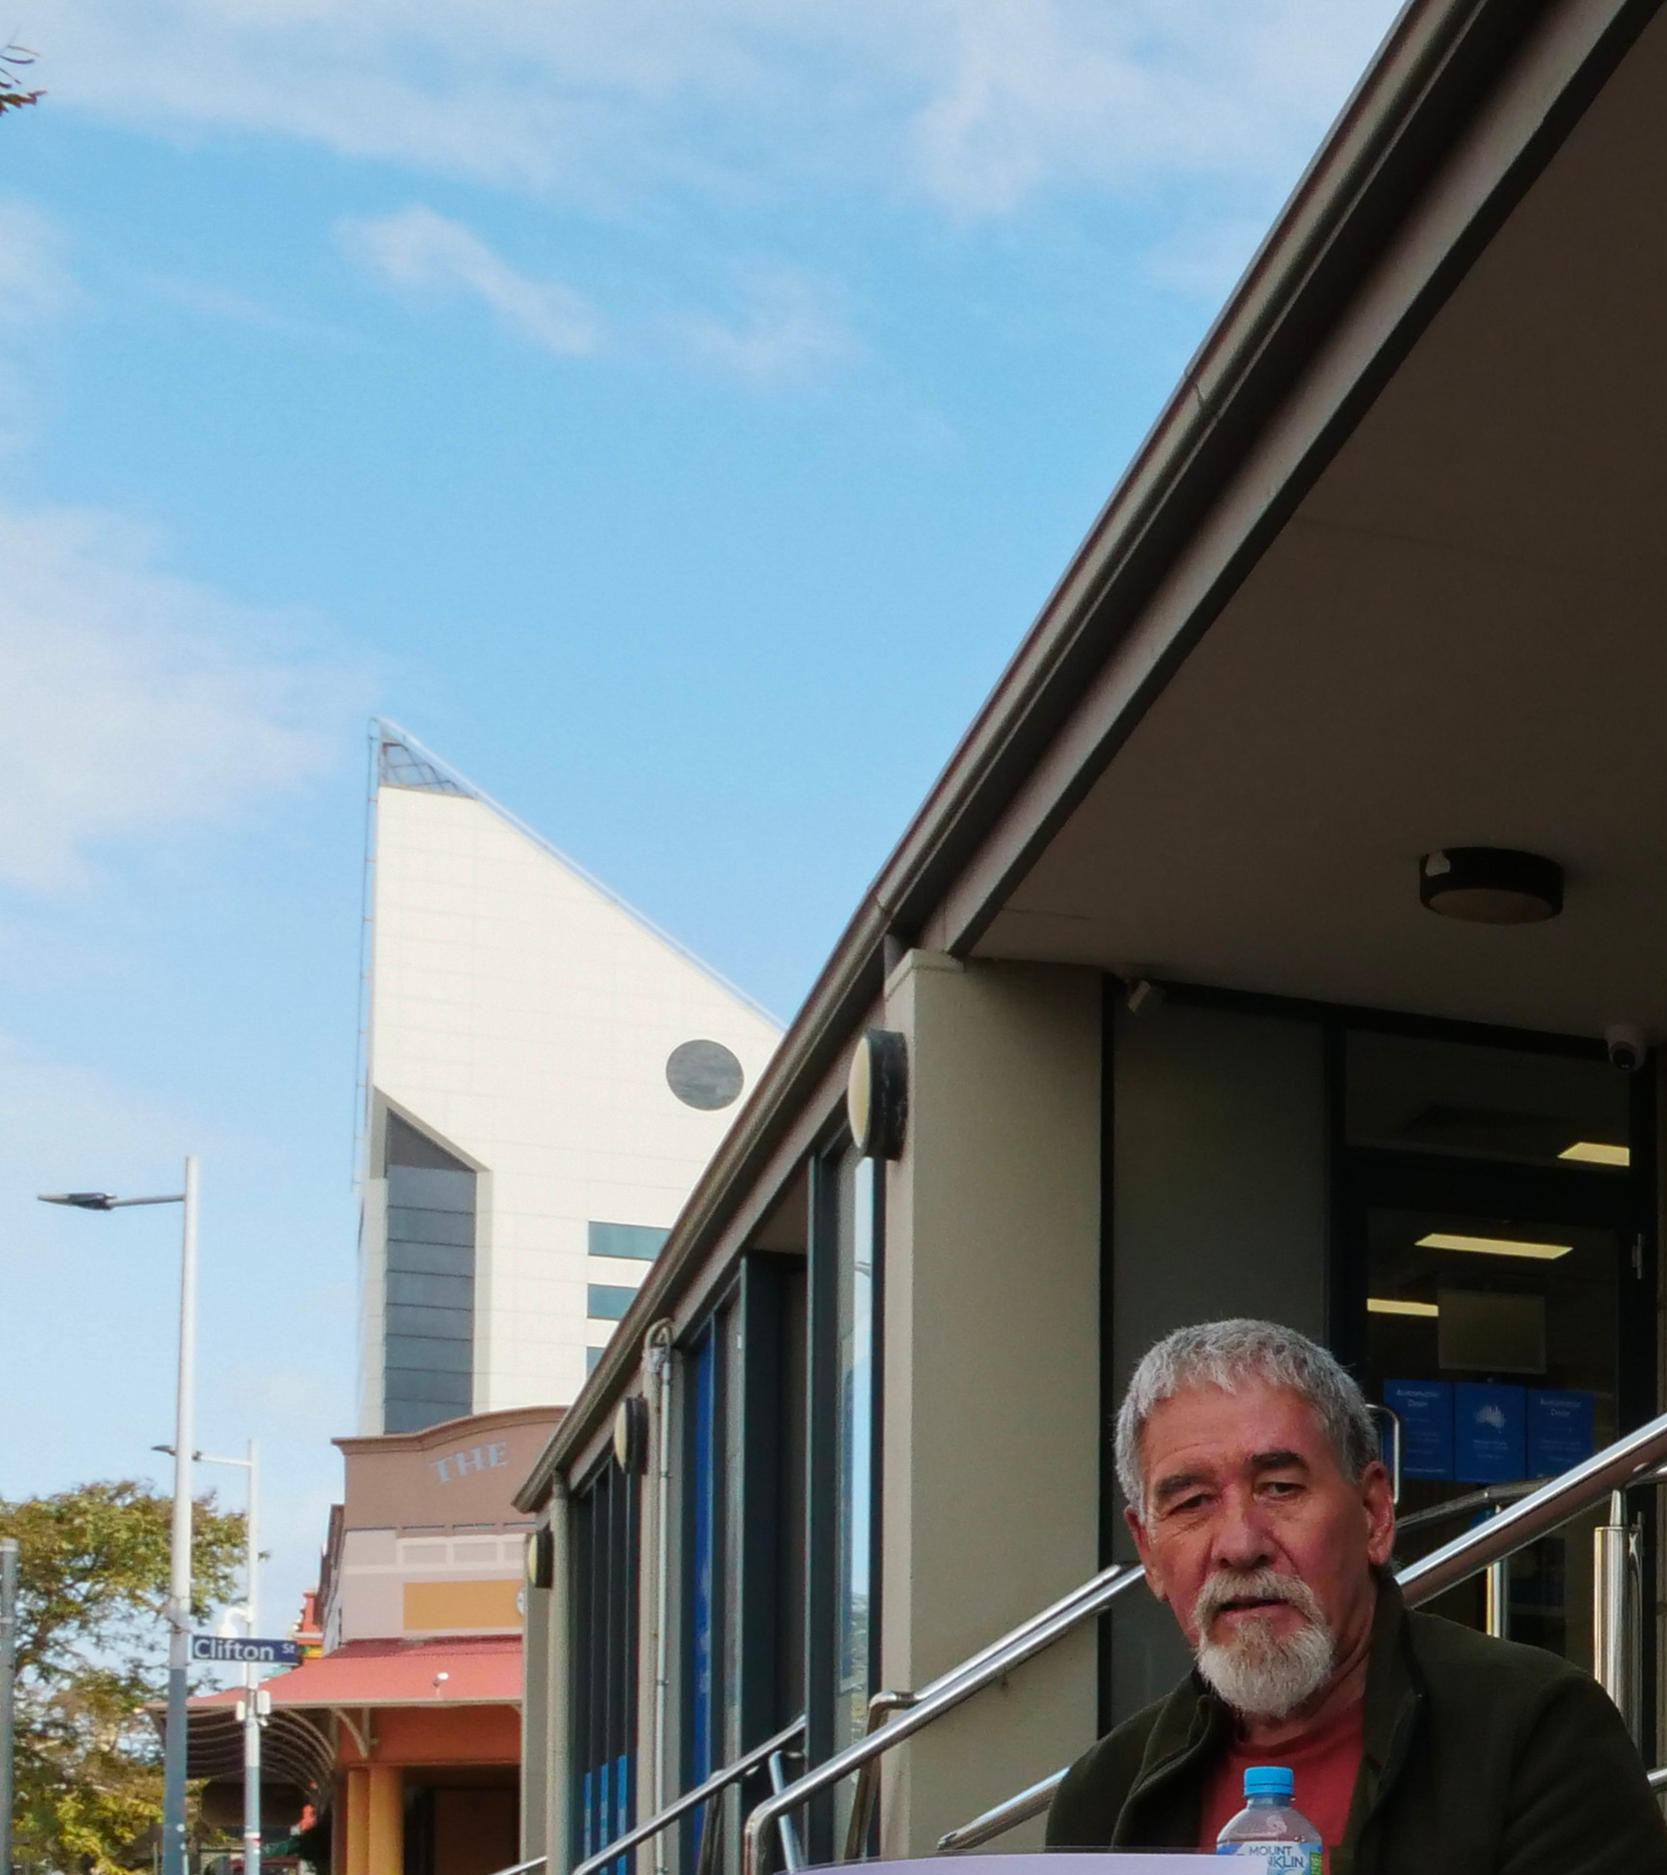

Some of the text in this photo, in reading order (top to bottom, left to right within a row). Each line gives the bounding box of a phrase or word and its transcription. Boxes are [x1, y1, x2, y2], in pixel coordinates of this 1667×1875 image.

[430, 1442, 508, 1483] THE
[194, 1638, 296, 1662] Clifton St
[1249, 1846, 1292, 1856] MOUNT
